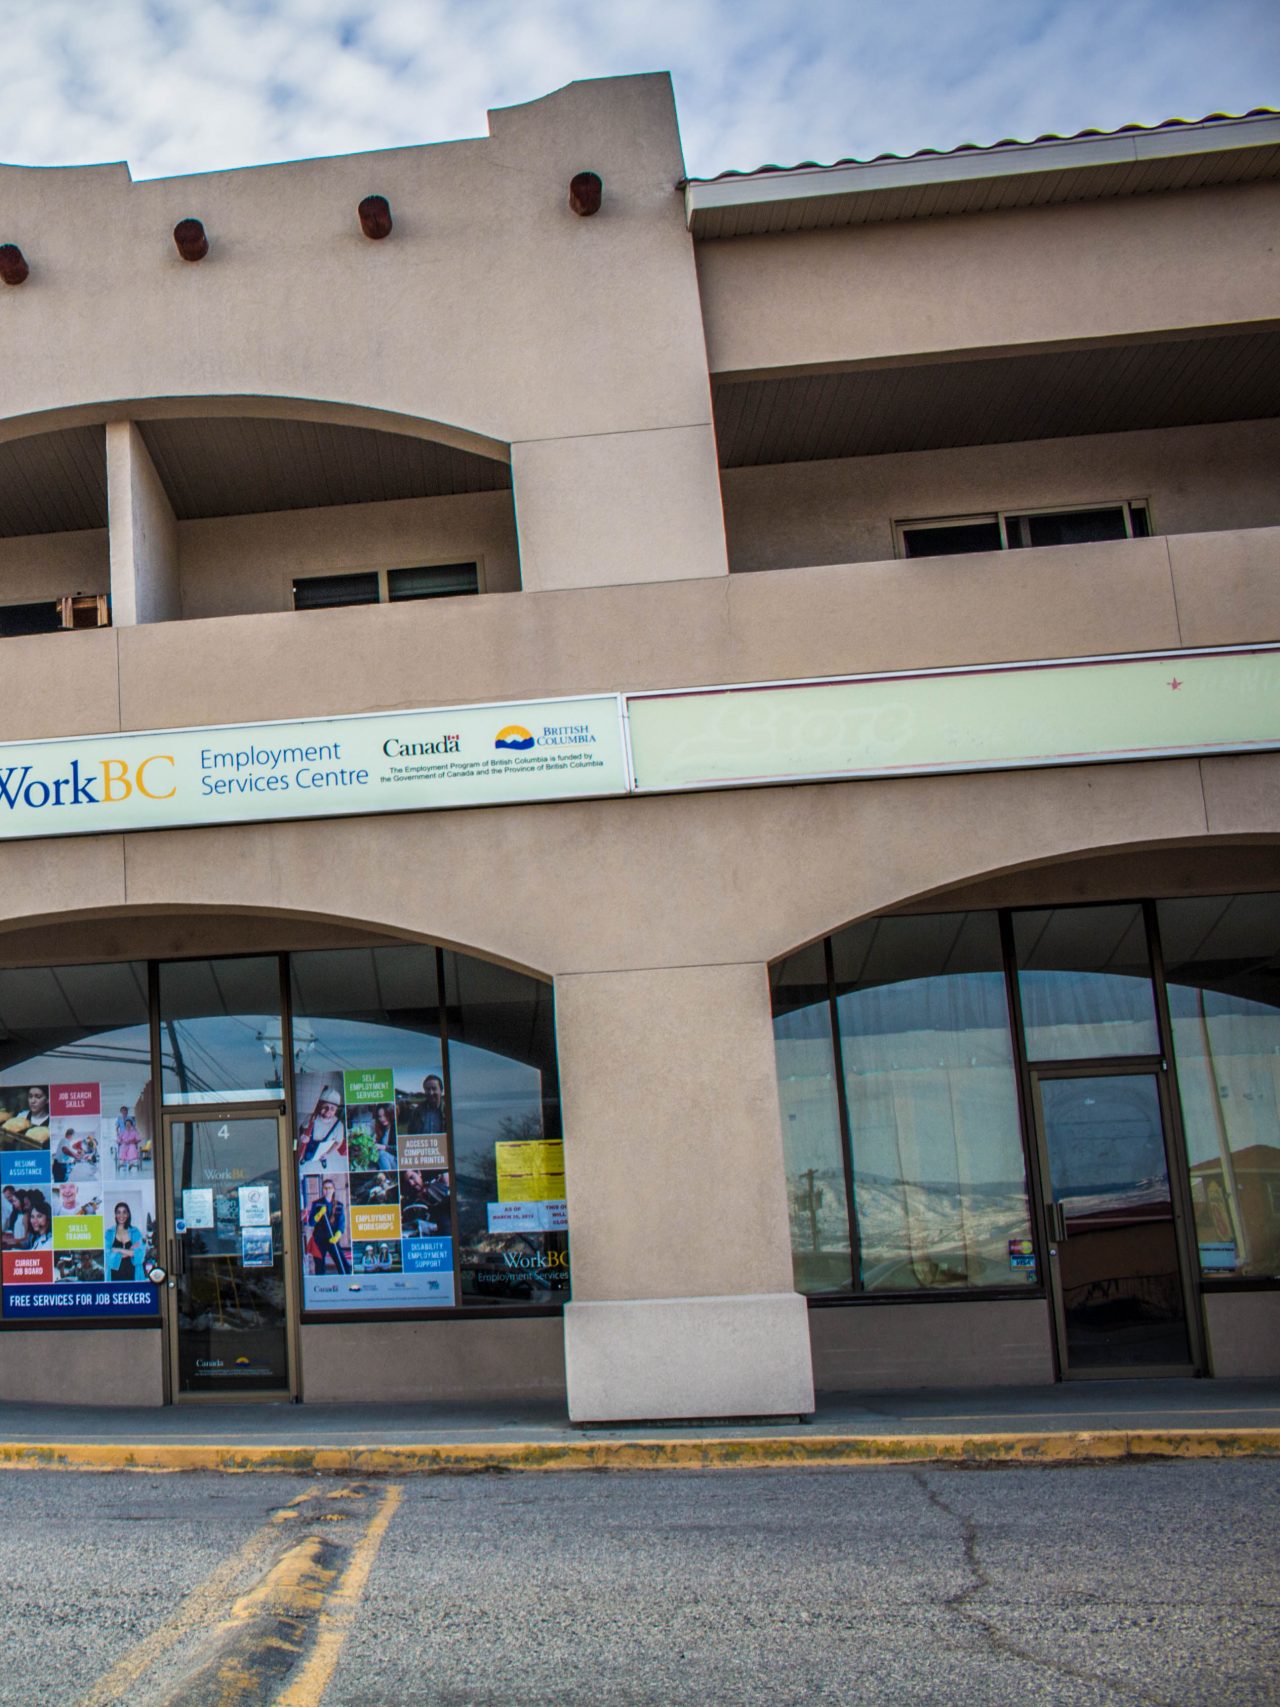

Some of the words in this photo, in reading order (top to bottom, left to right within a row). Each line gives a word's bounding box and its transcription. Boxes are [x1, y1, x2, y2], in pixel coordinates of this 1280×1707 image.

[543, 725, 589, 737] BRITISH
[536, 734, 597, 747] COLUMBIA
[382, 735, 461, 758] Canada
[201, 742, 341, 772] Employment
[404, 763, 448, 774] Employment
[450, 762, 480, 770] Program
[490, 758, 512, 766] British
[514, 757, 548, 765] Columbia
[558, 753, 582, 761] funded
[393, 773, 437, 782] Government
[446, 770, 474, 778] Canada
[504, 766, 535, 774] Province
[546, 762, 568, 770] British
[201, 772, 290, 796] Services
[295, 768, 369, 789] Centre
[361, 1074, 376, 1082] SELF
[349, 1082, 389, 1091] EMPLOYMENT
[70, 1091, 92, 1100] SEARCH
[356, 1090, 384, 1099] SERVICES
[65, 1100, 85, 1108] SKILLS
[218, 1124, 230, 1140] 4
[406, 1139, 429, 1148] ACCESS
[430, 1139, 438, 1147] TO
[400, 1157, 413, 1165] FAX
[420, 1155, 445, 1164] PRINTER
[9, 1168, 43, 1176] ASSISTANCE
[355, 1213, 395, 1223] EMPLOYMENT
[68, 1223, 89, 1232] SKILLS
[357, 1222, 394, 1231] WORKSHOPS
[65, 1232, 92, 1241] TRAINING
[411, 1243, 443, 1251] DISABILITY
[407, 1251, 448, 1260] EMPLOYMENT
[14, 1258, 40, 1267] CURRENT
[415, 1260, 441, 1268] SUPPORT
[13, 1267, 23, 1276] JOB
[24, 1267, 43, 1275] BOARD
[477, 1272, 532, 1283] Employment
[535, 1269, 568, 1280] Services
[9, 1294, 31, 1307] FREE
[33, 1293, 74, 1306] SERVICES
[75, 1293, 93, 1306] FOR
[95, 1292, 110, 1305] JOB
[112, 1292, 151, 1305] SEEKERS
